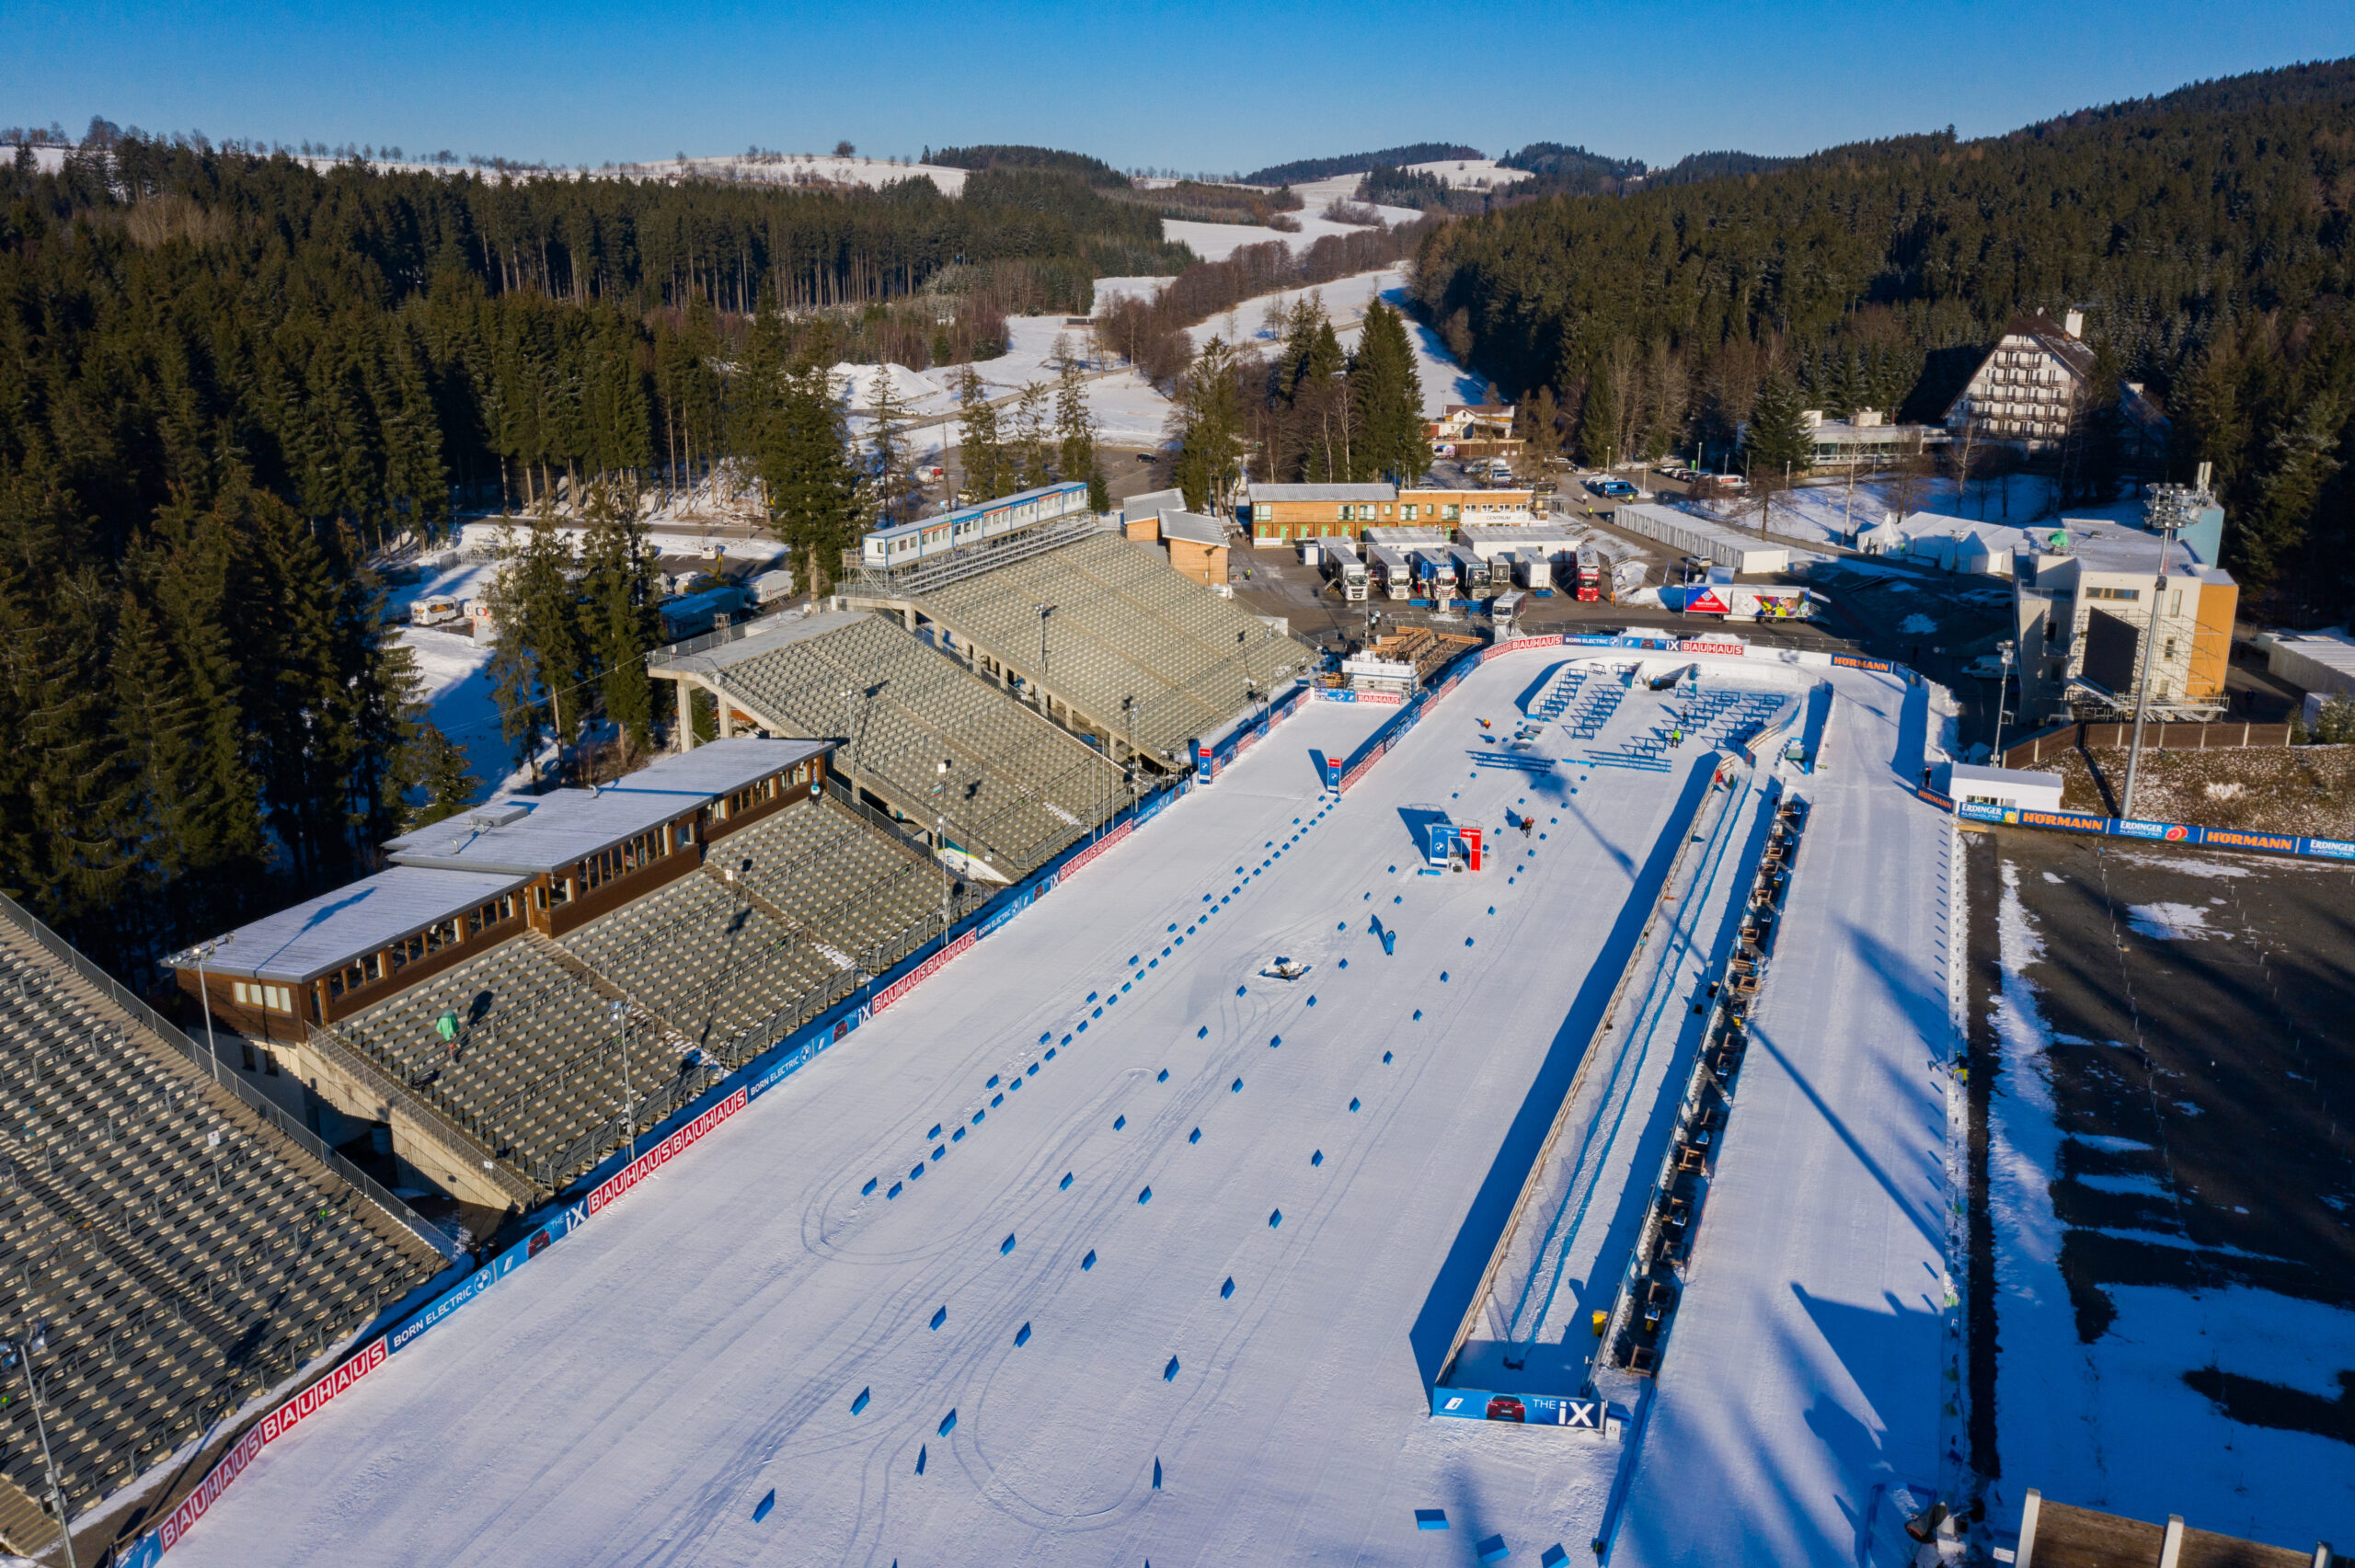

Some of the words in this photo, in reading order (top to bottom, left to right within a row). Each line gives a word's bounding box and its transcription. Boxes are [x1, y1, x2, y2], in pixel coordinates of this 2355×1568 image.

[1512, 635, 1562, 649] BAUHAUS
[1683, 641, 1742, 655] BAUHAUS
[1357, 694, 1400, 704] BAUHAUS
[1961, 803, 2002, 816] ERDINGER
[2023, 811, 2103, 831] HÖRMANN
[2120, 820, 2163, 833] ERDINGER
[2208, 830, 2292, 851] HÖRMANN
[2310, 839, 2355, 853] ERDINGER
[874, 965, 927, 1013] BAUHAUS
[927, 931, 976, 974] BAUHAUS
[858, 1002, 871, 1025] iX
[751, 1079, 769, 1095] BORN
[770, 1056, 799, 1082] ELECTRIC
[590, 1141, 672, 1211] BAUHAUS
[672, 1093, 747, 1153] BAUHAUS
[565, 1201, 587, 1233] iX
[394, 1320, 423, 1347] BORN
[425, 1286, 472, 1326] ELECTRIC
[263, 1345, 385, 1441] BAUHAUS
[1533, 1399, 1557, 1410] THE
[1558, 1401, 1595, 1427] iX
[162, 1431, 260, 1547] BAUHAUS
